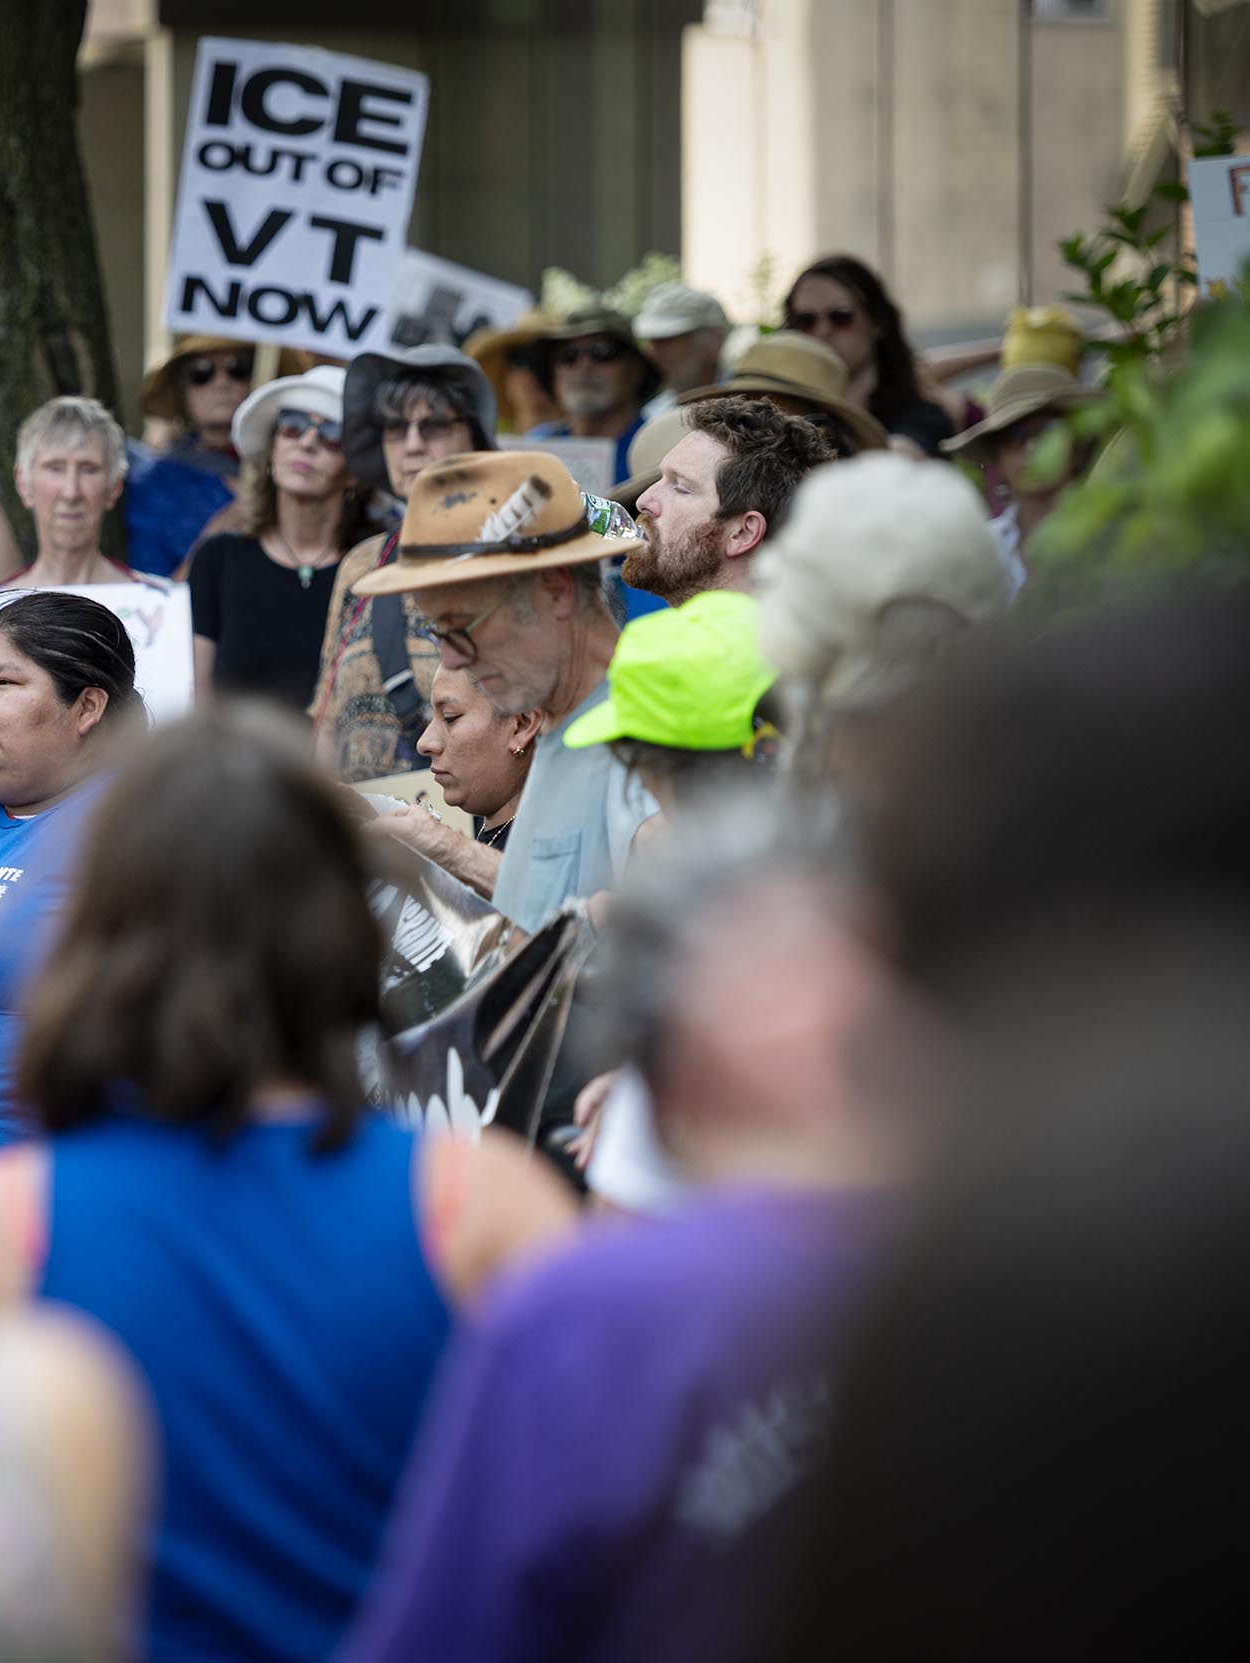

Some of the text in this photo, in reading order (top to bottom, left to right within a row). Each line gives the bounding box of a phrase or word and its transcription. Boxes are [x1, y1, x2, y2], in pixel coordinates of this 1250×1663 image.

[206, 61, 412, 157] ICE
[198, 140, 405, 197] OUT OF
[202, 199, 387, 287] VT
[180, 276, 380, 342] NOW
